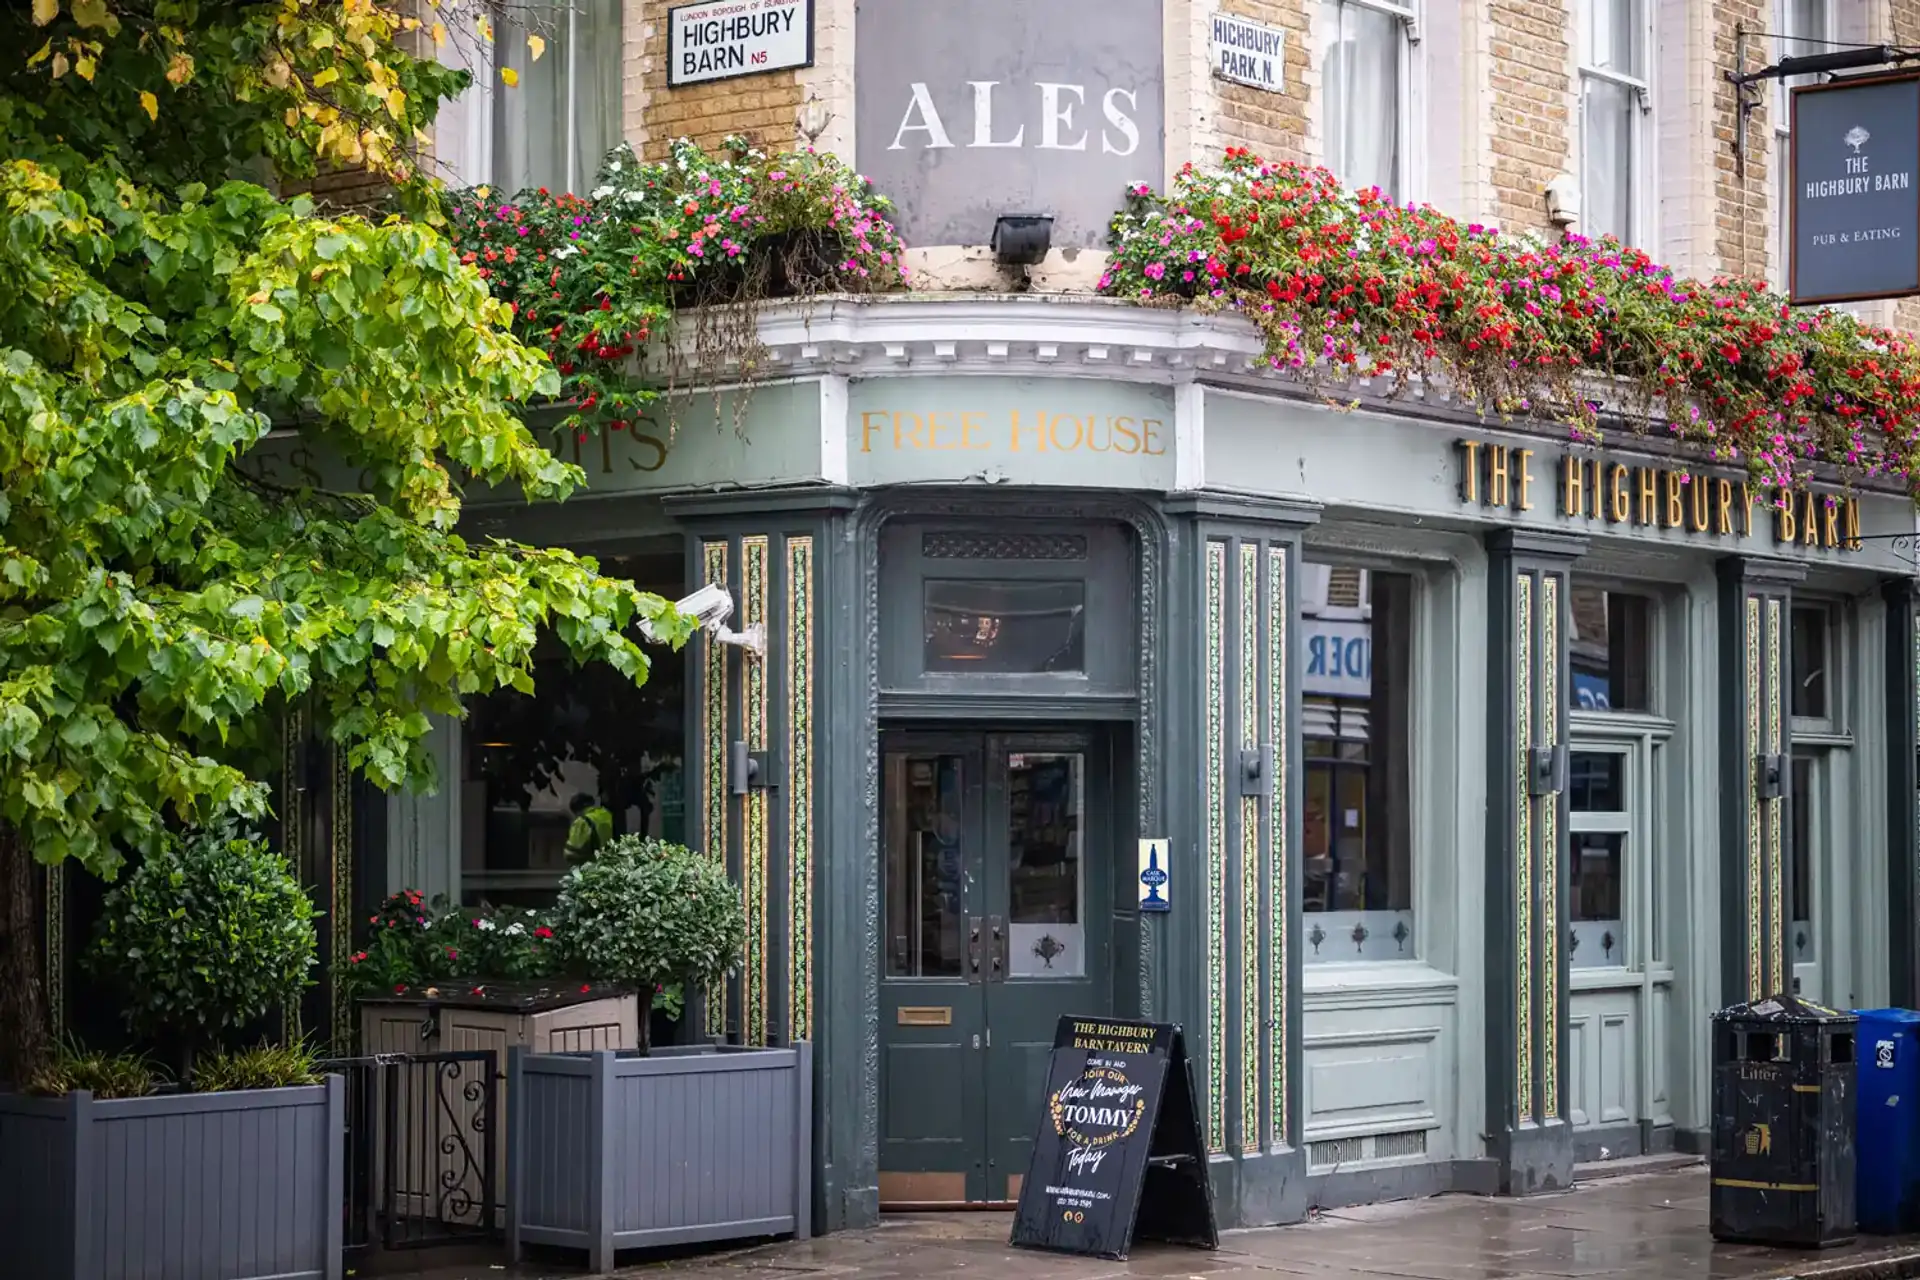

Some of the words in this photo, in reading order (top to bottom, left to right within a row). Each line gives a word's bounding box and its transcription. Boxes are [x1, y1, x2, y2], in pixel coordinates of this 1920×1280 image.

[679, 10, 709, 22] LONDON
[712, 4, 747, 17] BOROUGH
[750, 2, 761, 10] OF
[683, 8, 796, 48] HIGHBURY
[683, 44, 744, 75] BARN
[751, 51, 768, 65] N5
[887, 80, 1140, 156] ALES
[1844, 156, 1869, 174] THE
[1806, 176, 1870, 199] HIGHBURY
[1875, 172, 1909, 192] BARN
[1812, 233, 1836, 246] PUB
[1840, 232, 1850, 243] &
[1854, 227, 1901, 242] EATING
[860, 409, 991, 453] FREE
[1008, 408, 1167, 455] HOUSE
[1461, 440, 1534, 511] THE
[1564, 454, 1753, 537] HIGHBURY
[1779, 488, 1861, 551] BARN
[1073, 1022, 1096, 1034] THE
[1097, 1024, 1157, 1039] HIGHBURY
[1073, 1038, 1105, 1051] BARN
[1106, 1040, 1151, 1054] TAVERN
[1084, 1069, 1105, 1079] JOIN
[1107, 1071, 1127, 1085] OUR
[1064, 1104, 1135, 1128] TOMMY
[1066, 1127, 1083, 1143] FOR
[1083, 1136, 1090, 1145] A
[1092, 1130, 1120, 1146] DRINK
[1066, 1143, 1108, 1176] Today
